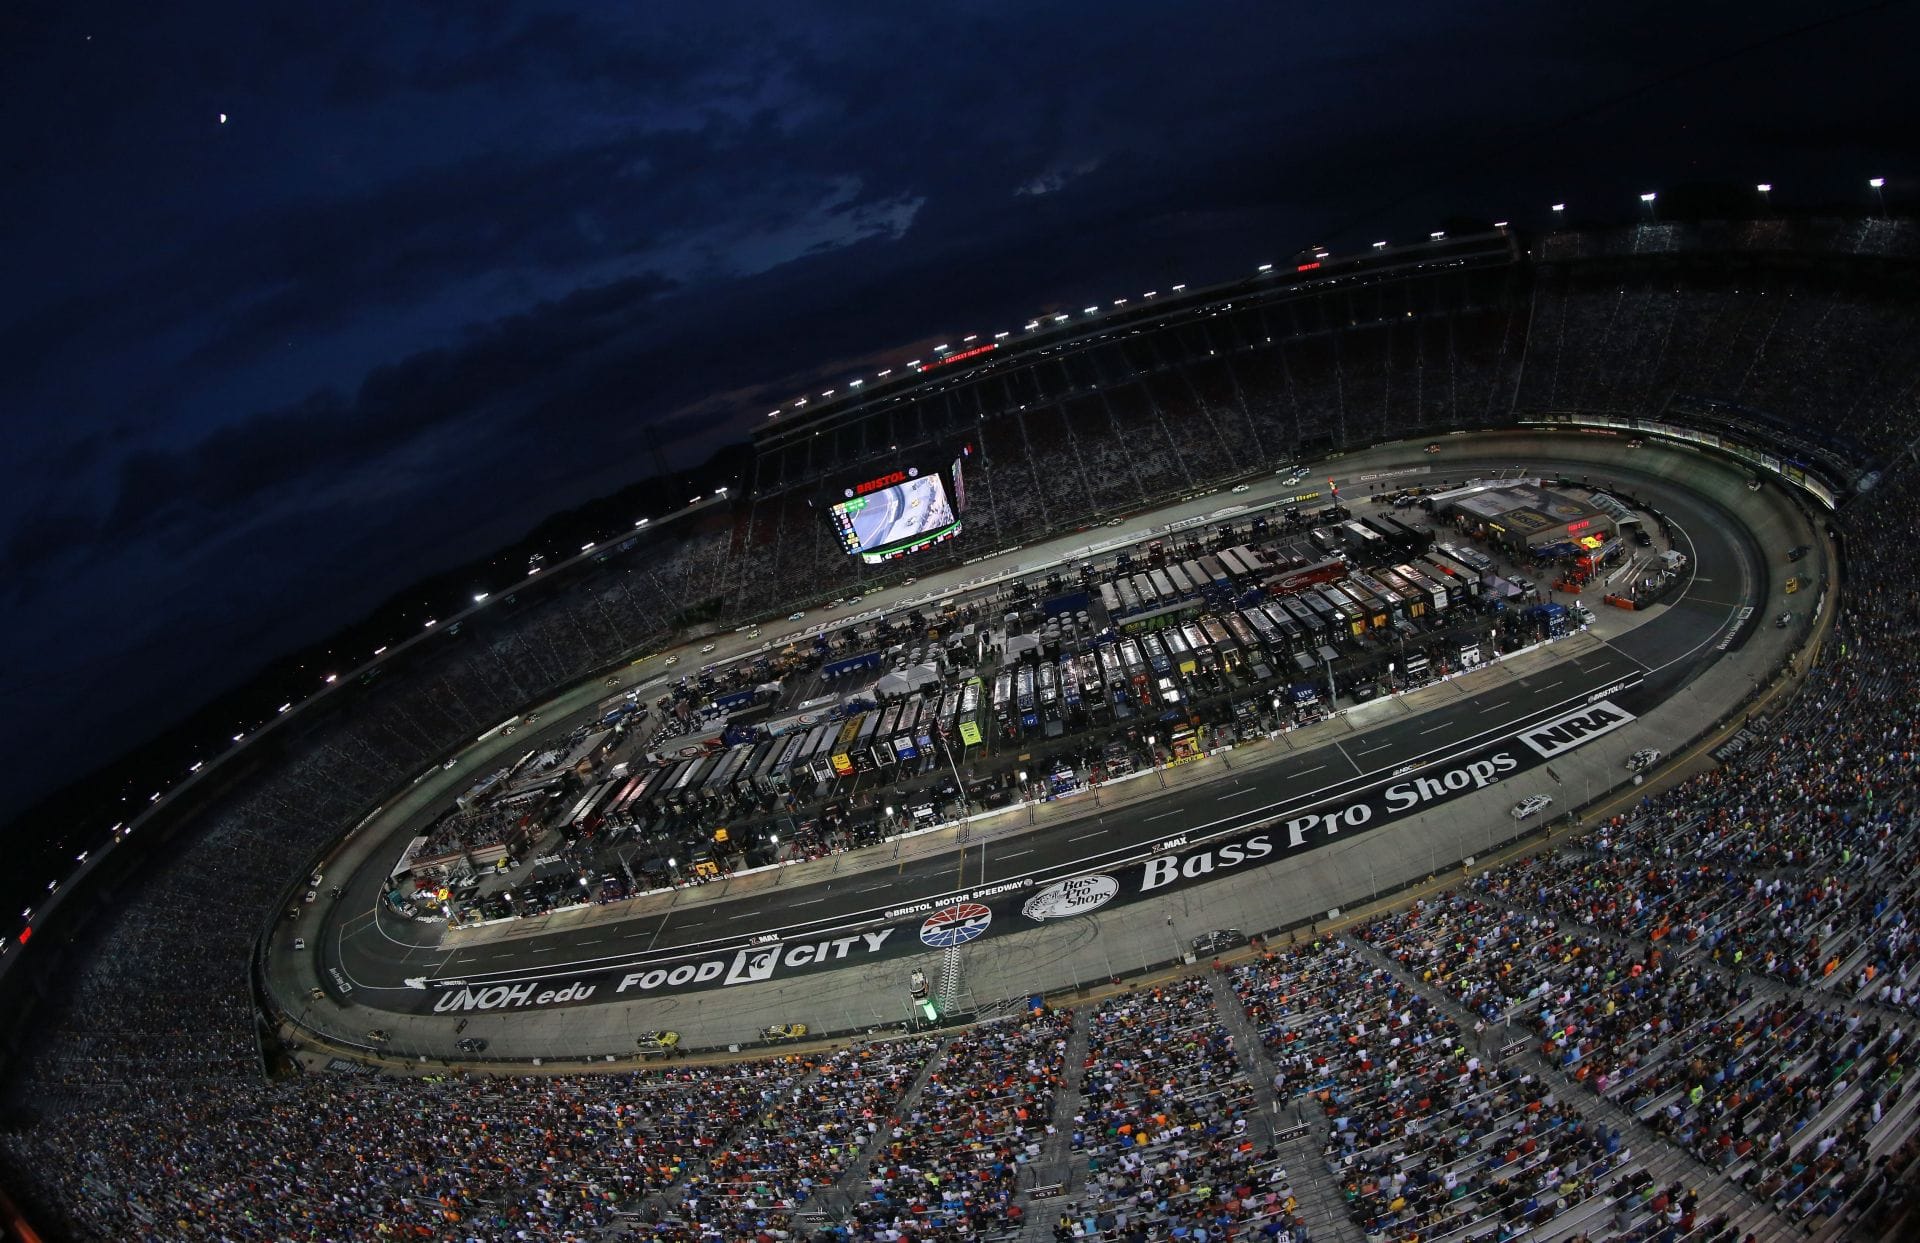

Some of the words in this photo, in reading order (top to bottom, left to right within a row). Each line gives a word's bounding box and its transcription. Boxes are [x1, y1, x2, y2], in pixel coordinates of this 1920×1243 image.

[855, 471, 906, 494] BRISTOL
[1593, 685, 1619, 702] BRISTOL
[1530, 708, 1625, 751] NRA
[1139, 835, 1273, 893] Bass
[1285, 803, 1372, 848] Pro
[1384, 752, 1518, 814] Shops
[1063, 876, 1099, 893] Bass
[1064, 887, 1091, 900] Pro
[893, 902, 932, 917] BRISTOL
[935, 893, 969, 908] MOTOR
[972, 880, 1023, 899] SPEEDWAY
[1066, 890, 1111, 909] Shops
[616, 961, 724, 993] FOOD
[784, 928, 896, 967] CITY
[433, 982, 597, 1013] UNOH.edu
